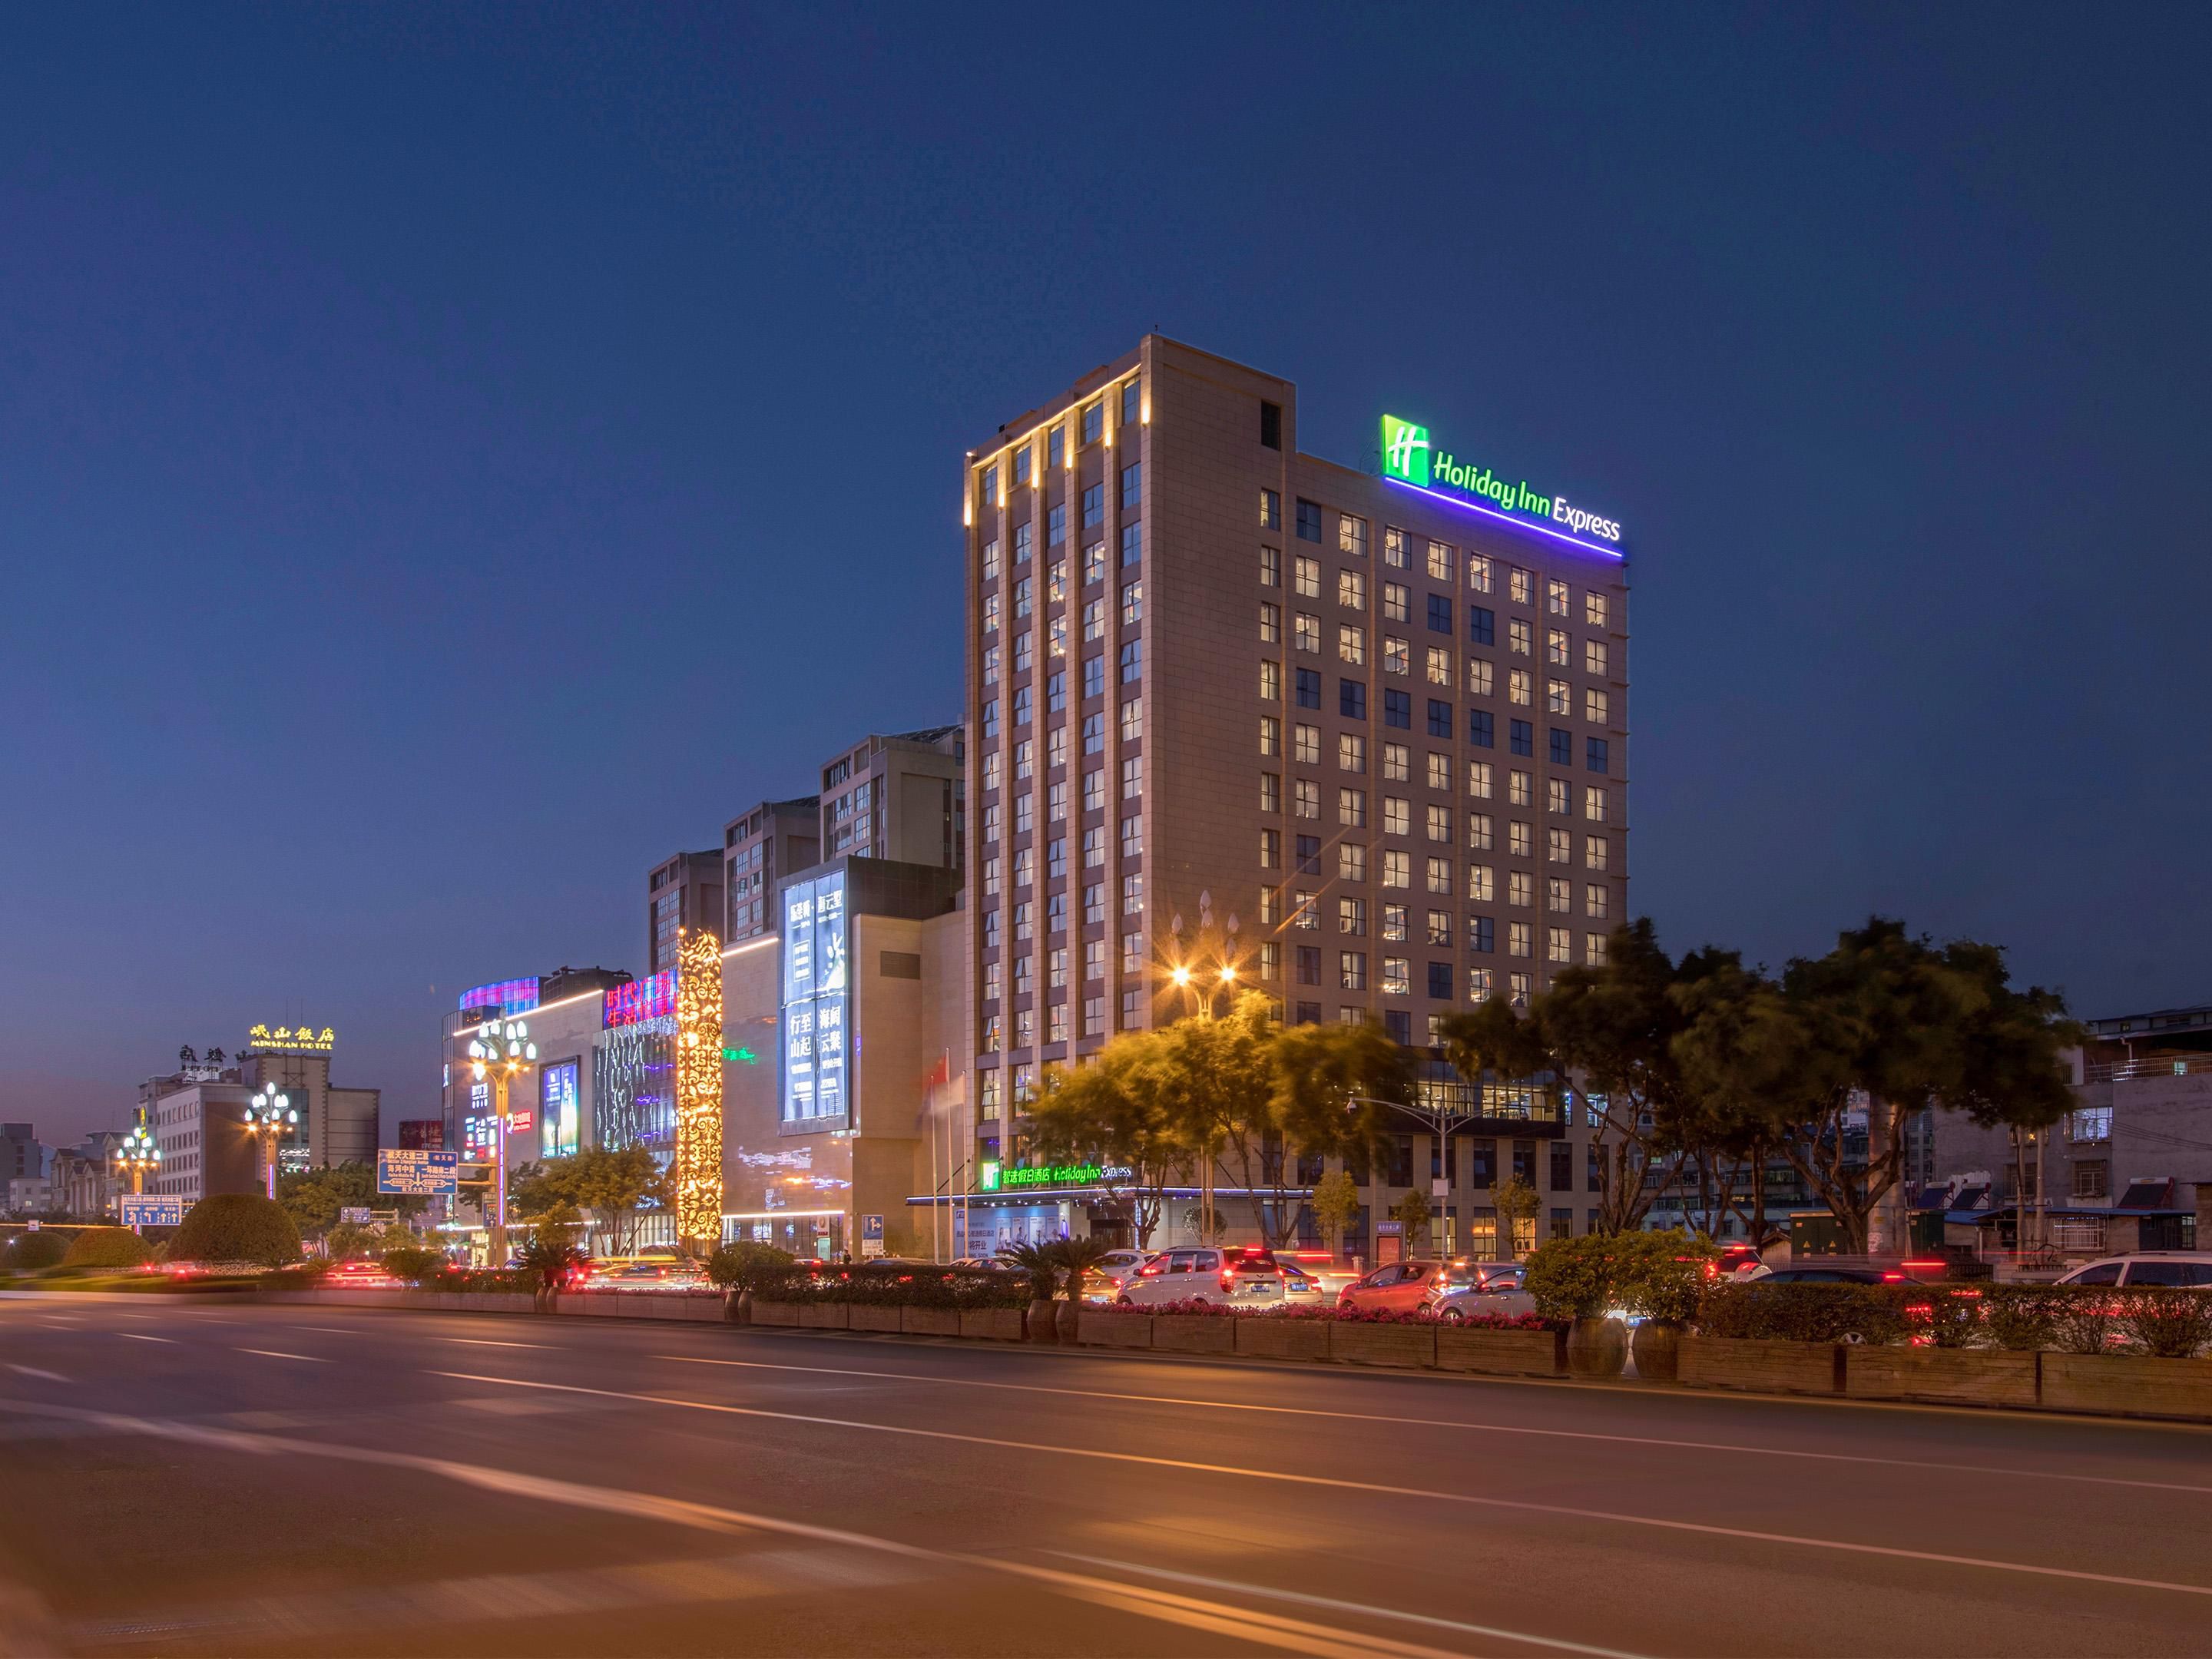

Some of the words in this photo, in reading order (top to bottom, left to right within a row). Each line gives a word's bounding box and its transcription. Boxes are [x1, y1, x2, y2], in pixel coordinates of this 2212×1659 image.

[1434, 450, 1517, 511] Holiday
[1518, 480, 1551, 518] Inn
[1552, 496, 1621, 541] Express
[250, 1040, 299, 1049] MINSHAN
[300, 1041, 333, 1050] HOTEL
[1002, 1167, 1050, 1184] 智选假日酒店
[1054, 1165, 1087, 1183] Holiday
[1087, 1164, 1101, 1181] Inn
[1101, 1165, 1132, 1180] Express
